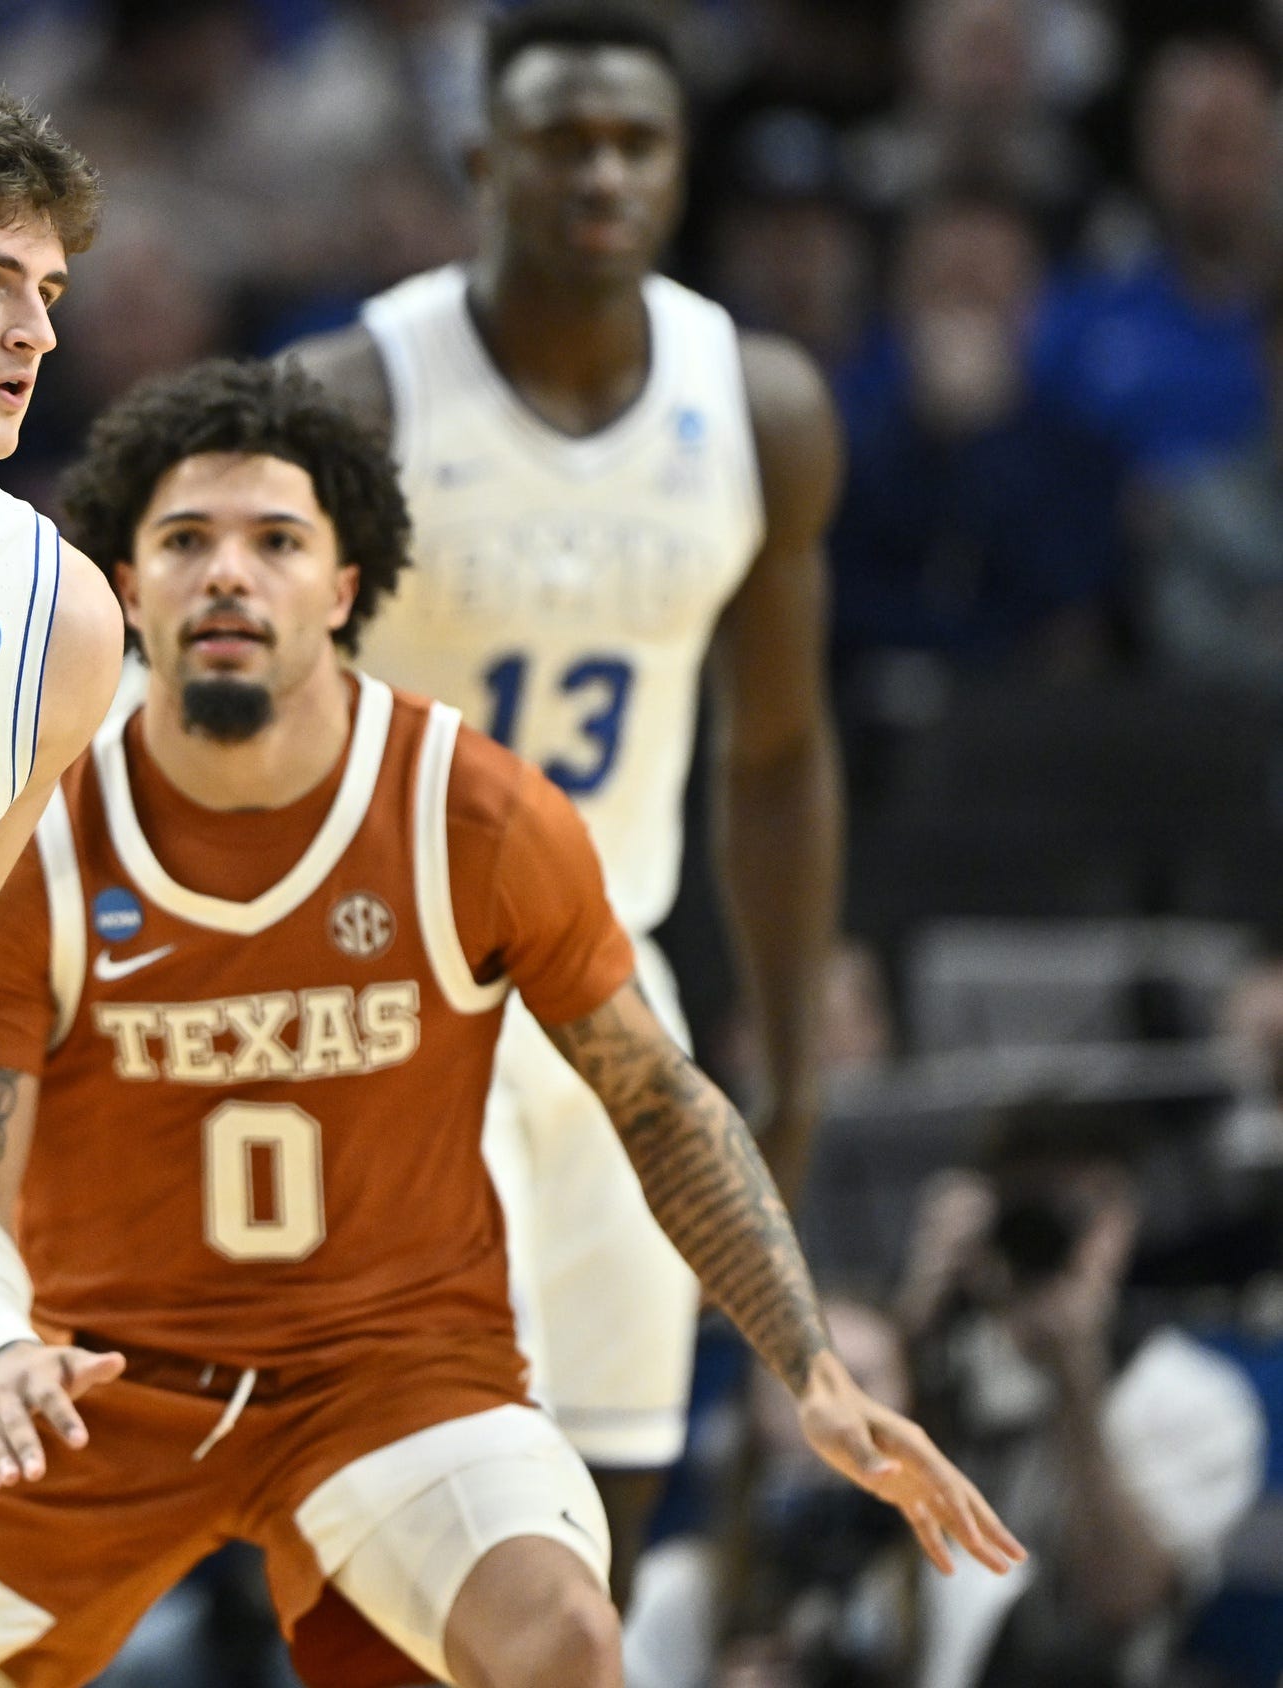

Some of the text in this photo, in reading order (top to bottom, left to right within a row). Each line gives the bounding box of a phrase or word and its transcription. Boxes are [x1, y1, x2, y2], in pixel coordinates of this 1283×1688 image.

[483, 649, 636, 796] 13
[331, 894, 392, 954] SEC
[92, 979, 421, 1087] TEXAS
[201, 1100, 326, 1264] 0
